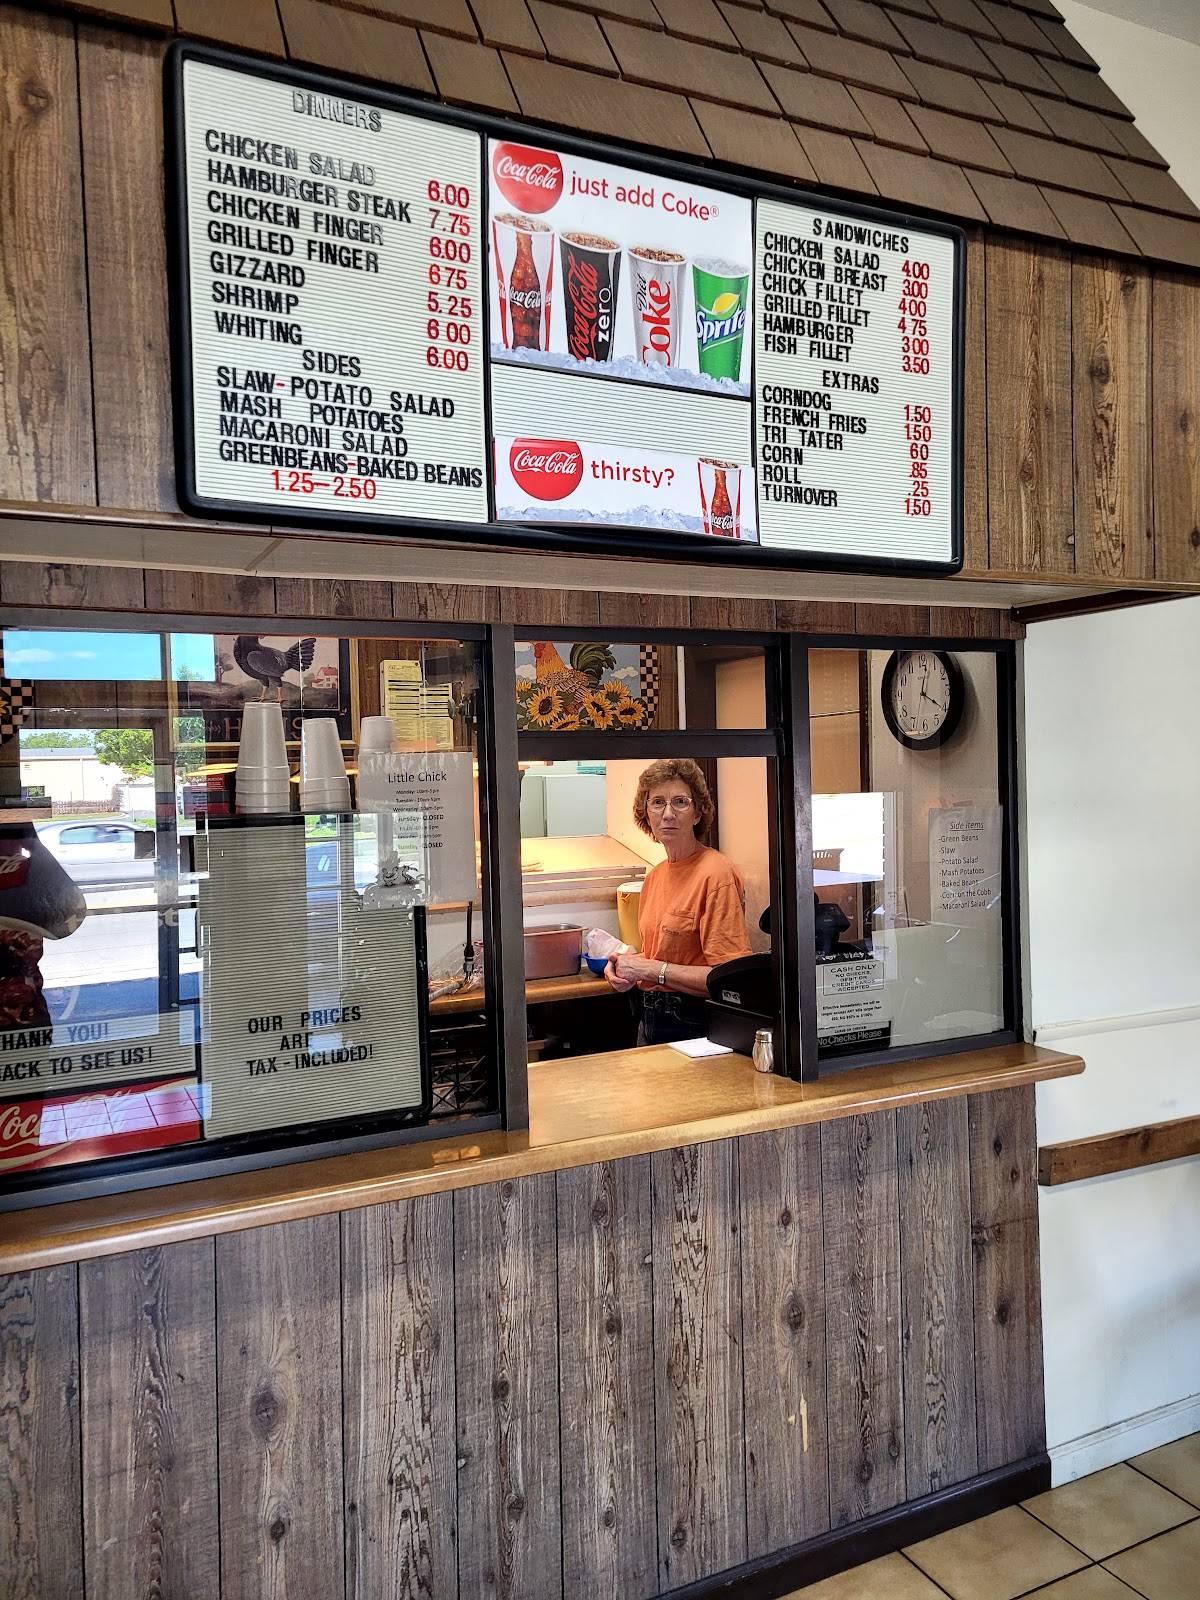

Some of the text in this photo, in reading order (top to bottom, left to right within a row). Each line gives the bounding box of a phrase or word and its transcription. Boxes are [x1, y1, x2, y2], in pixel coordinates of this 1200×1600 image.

[292, 90, 382, 132] DINNERS
[205, 129, 470, 208] CHICKEN SALAD 6.00
[497, 155, 562, 191] Coca-Cola
[207, 158, 470, 236] HAMBURGER STEAK 7.75
[570, 171, 609, 195] just
[615, 185, 655, 208] add
[207, 190, 471, 264] CHICKEN FINGER 6.00
[813, 218, 909, 253] SANDWICHES
[207, 220, 294, 256] GRILLED
[306, 239, 379, 273] FINGER
[764, 231, 823, 260] CHICKEN
[834, 246, 880, 270] SALAD
[210, 250, 472, 318] GIZZARD 5.25
[763, 252, 825, 280] CHICKEN
[834, 266, 887, 291] BREAST
[212, 281, 299, 315] SHRIMP
[637, 273, 648, 311] Diet
[763, 273, 807, 297] CHICK
[816, 282, 863, 307] FILLET
[597, 286, 612, 343] zero
[695, 305, 746, 345] Sprite
[764, 294, 822, 319] GRILLED
[828, 305, 870, 327] FILLET
[215, 310, 469, 371] WHITING 6.00
[763, 313, 854, 344] HAMBURGER
[302, 349, 362, 377] SIDES
[764, 333, 930, 375] FISH FILLET 3.50
[291, 376, 373, 407] POTATO
[391, 391, 455, 418] SALAD
[822, 370, 880, 394] EXTRAS
[220, 391, 404, 435] MASH POTATOES
[762, 385, 931, 423] CORNDOG 1.50
[763, 405, 820, 428] FRENCH
[829, 413, 867, 434] FRIES
[219, 415, 408, 458] MACARONI SALAD
[762, 424, 787, 444] TRI
[799, 429, 843, 450] TATER
[513, 449, 580, 475] Coca-Cola
[762, 444, 803, 465] CORN
[424, 463, 483, 488] BEANS
[591, 460, 675, 488] thirsty?
[763, 464, 929, 497] ROLL .25
[763, 484, 838, 507] TURNOVER
[225, 717, 303, 740] HS
[922, 718, 928, 731] 6
[388, 771, 447, 784] Little Chick
[961, 834, 979, 842] Beans
[960, 868, 985, 876] Potatoes
[962, 856, 979, 864] Salad
[830, 966, 853, 974] CASH
[837, 984, 870, 992] ACCEPTED
[248, 1005, 362, 1034] OUR PRICES
[0, 1022, 109, 1051] HANK YOU!
[828, 1033, 857, 1044] Checks
[857, 1030, 882, 1039] Please
[0, 1046, 153, 1082] ACK TO SEE US!
